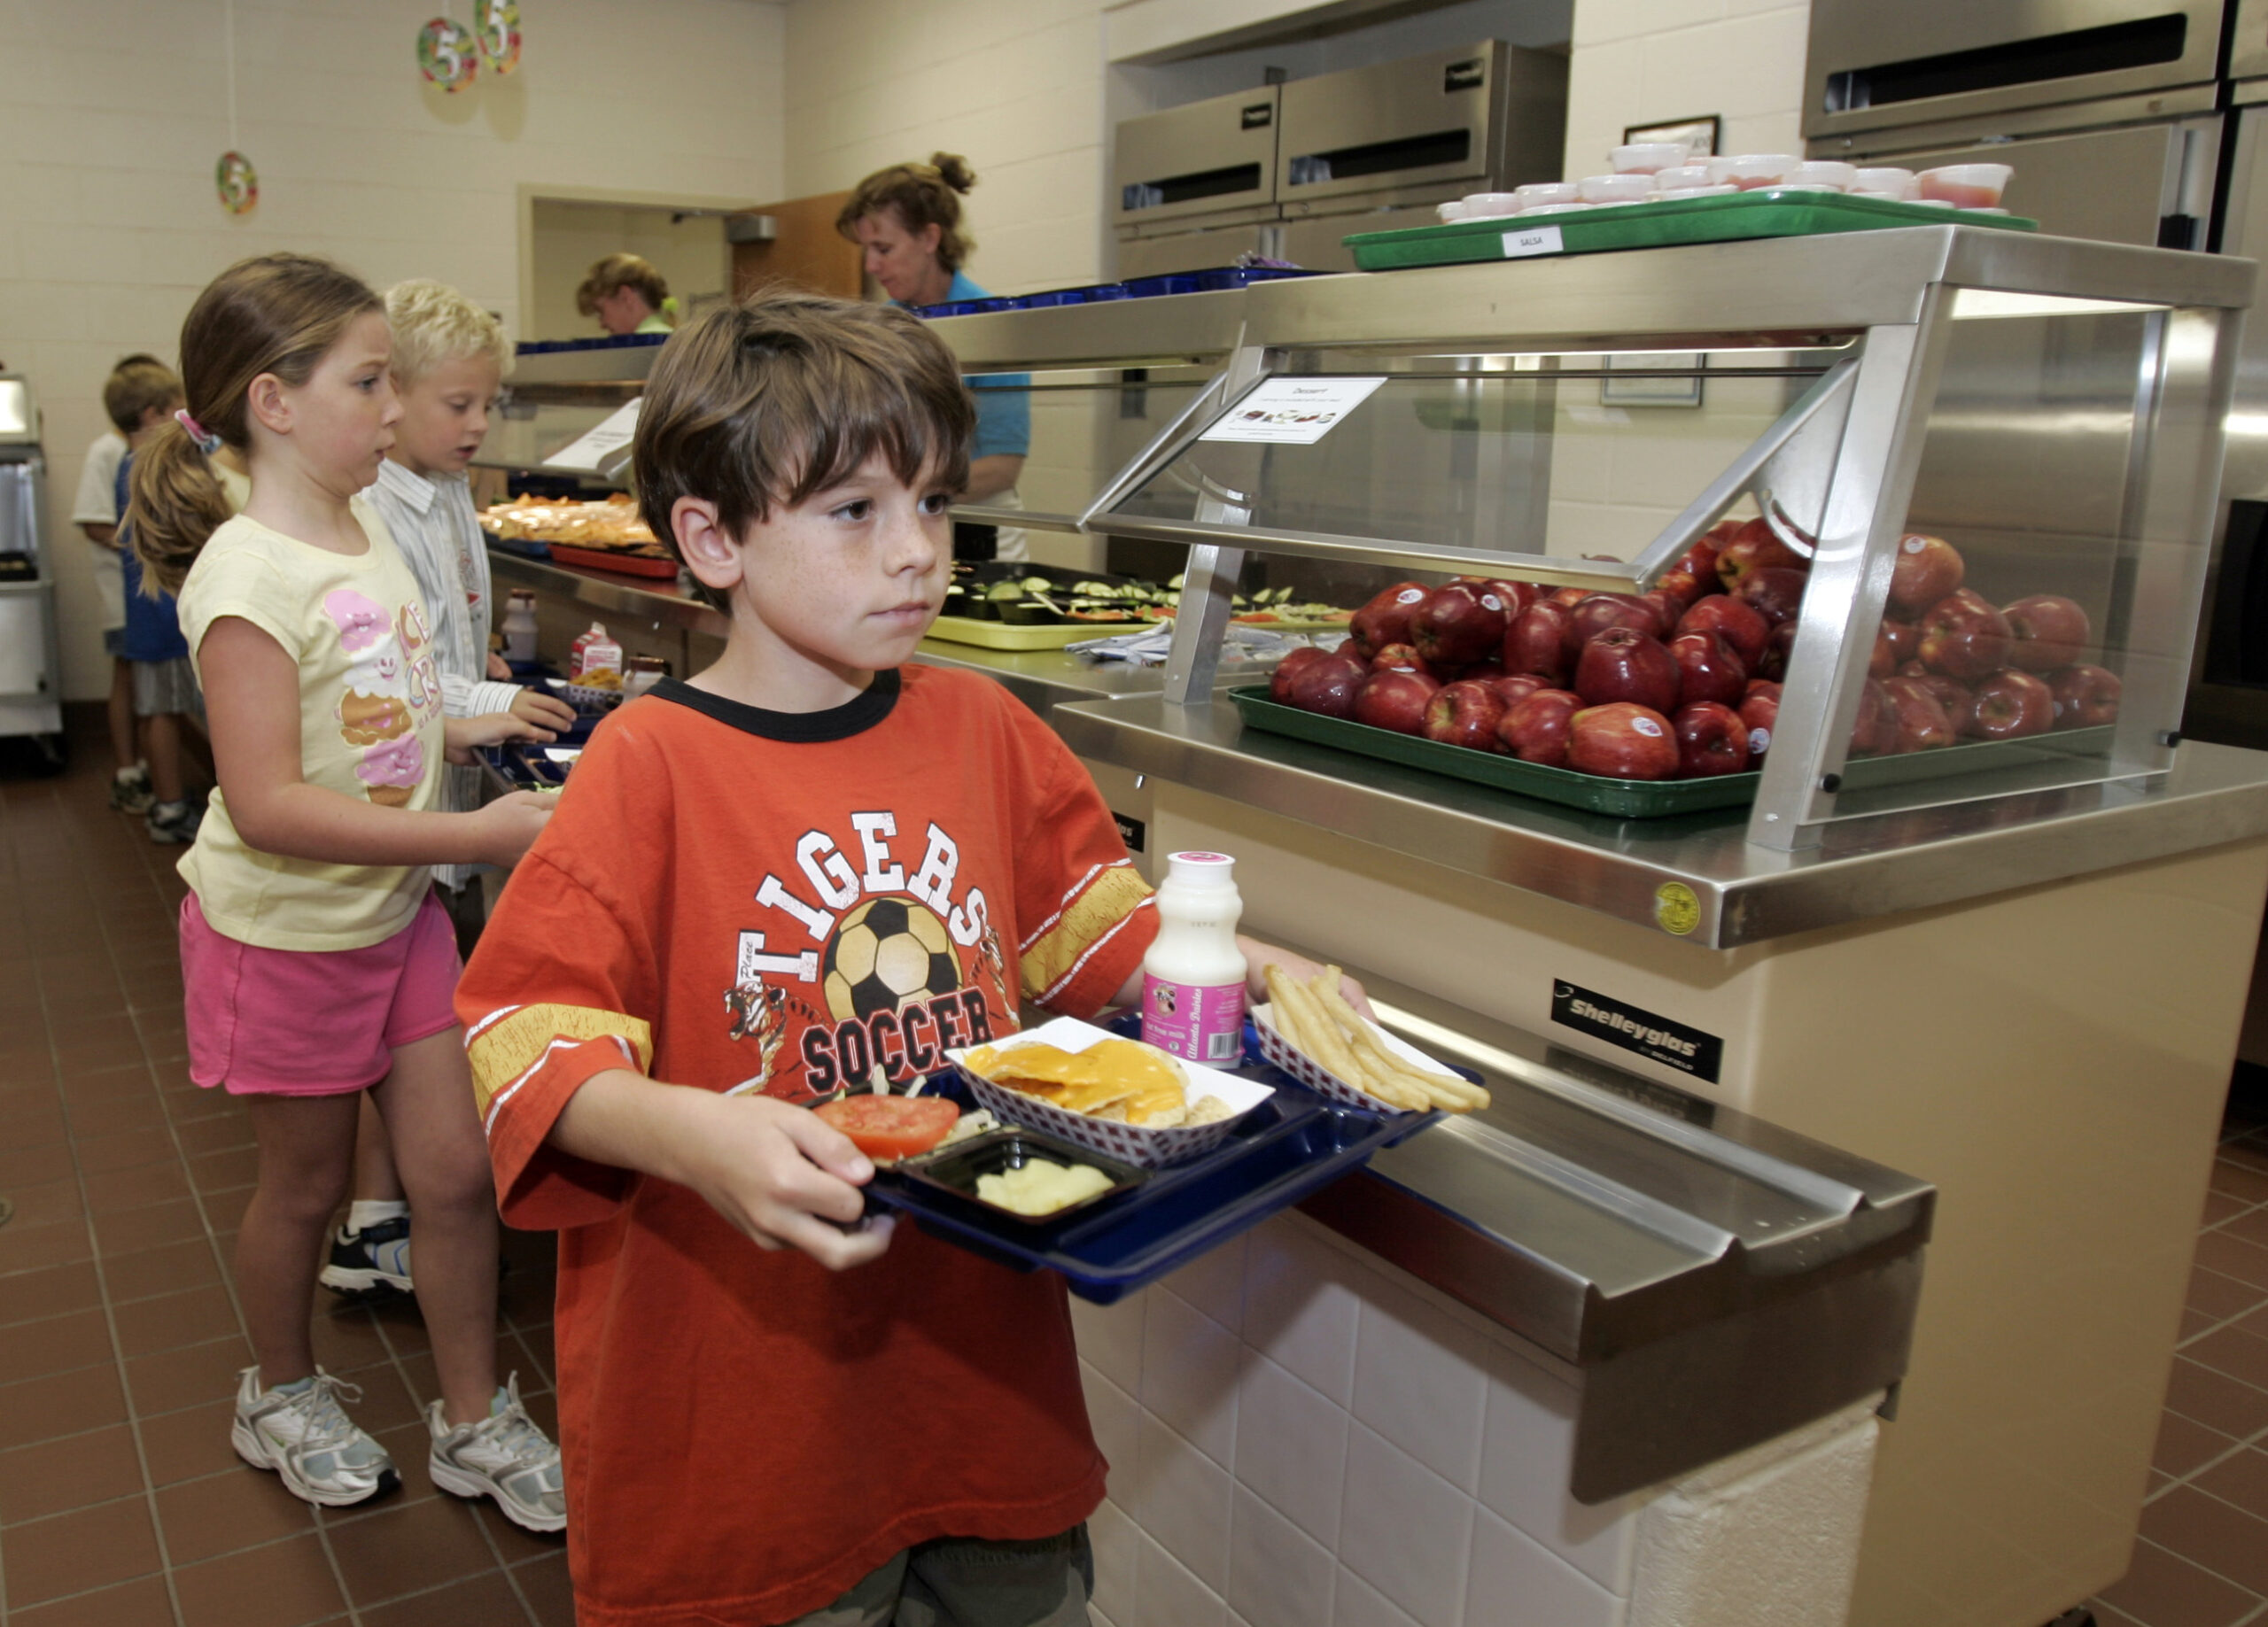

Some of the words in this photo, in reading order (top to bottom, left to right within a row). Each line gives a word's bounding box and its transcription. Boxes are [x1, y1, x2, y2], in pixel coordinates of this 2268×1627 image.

[432, 29, 460, 81] 5
[227, 162, 248, 204] 5
[1520, 236, 1543, 246] SALSA
[395, 600, 431, 661] ICE
[736, 810, 988, 987] TIGERS
[740, 941, 753, 980] Place
[1189, 988, 1202, 1022] Dairies
[800, 986, 994, 1096] SOCCER
[1186, 1023, 1200, 1059] Atlanta
[1570, 998, 1696, 1058] Shelleyglas
[1651, 1050, 1694, 1071] DELFIELD
